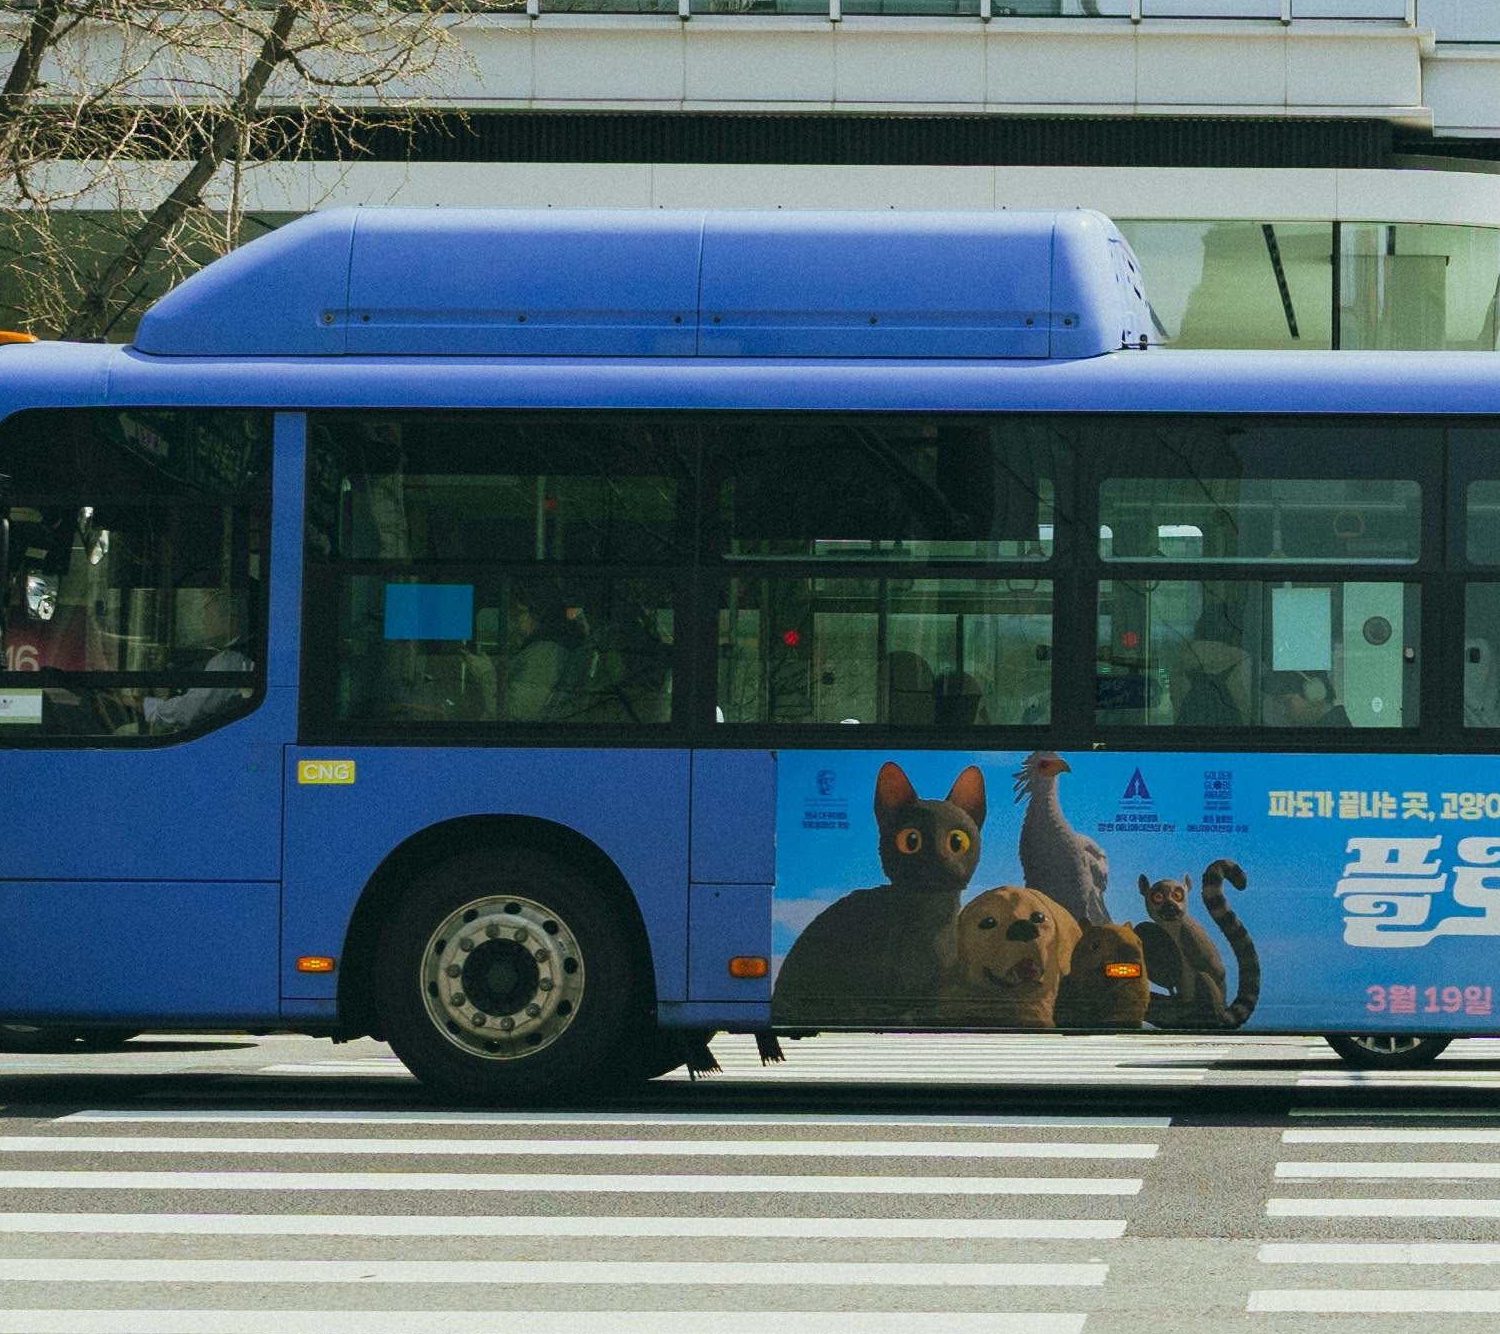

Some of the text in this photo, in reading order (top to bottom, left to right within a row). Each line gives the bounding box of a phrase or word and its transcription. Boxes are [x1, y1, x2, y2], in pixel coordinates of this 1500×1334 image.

[303, 763, 350, 780] CNG
[1203, 770, 1233, 780] GOLDEN
[1268, 791, 1334, 819] 파도가
[1338, 791, 1397, 819] 끝나는
[1401, 791, 1435, 823] 곳,
[1366, 985, 1418, 1016] 3월
[1423, 985, 1492, 1016] 19일
